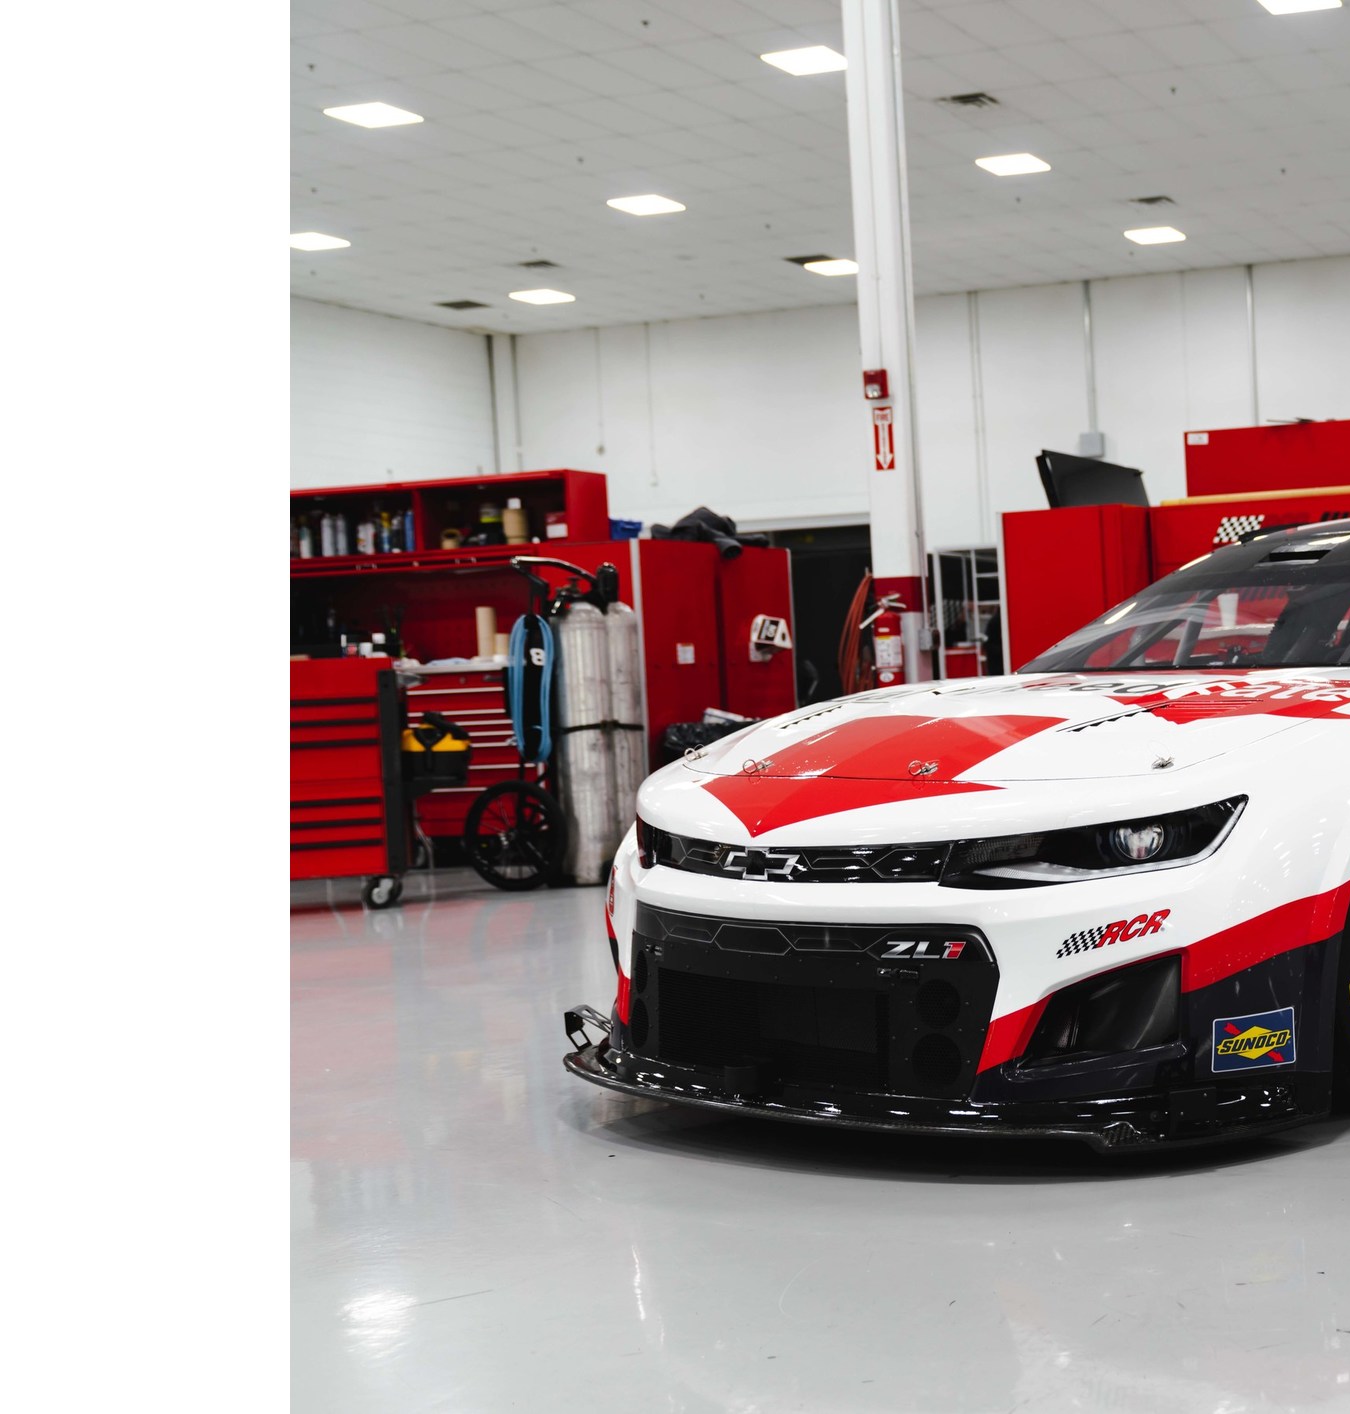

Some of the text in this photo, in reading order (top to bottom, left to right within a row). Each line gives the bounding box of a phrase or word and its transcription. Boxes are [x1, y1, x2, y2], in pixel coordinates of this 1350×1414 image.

[530, 647, 547, 666] 8
[1095, 909, 1171, 948] RCR
[880, 941, 967, 959] ZL1
[1219, 1031, 1289, 1054] SUNOCO
